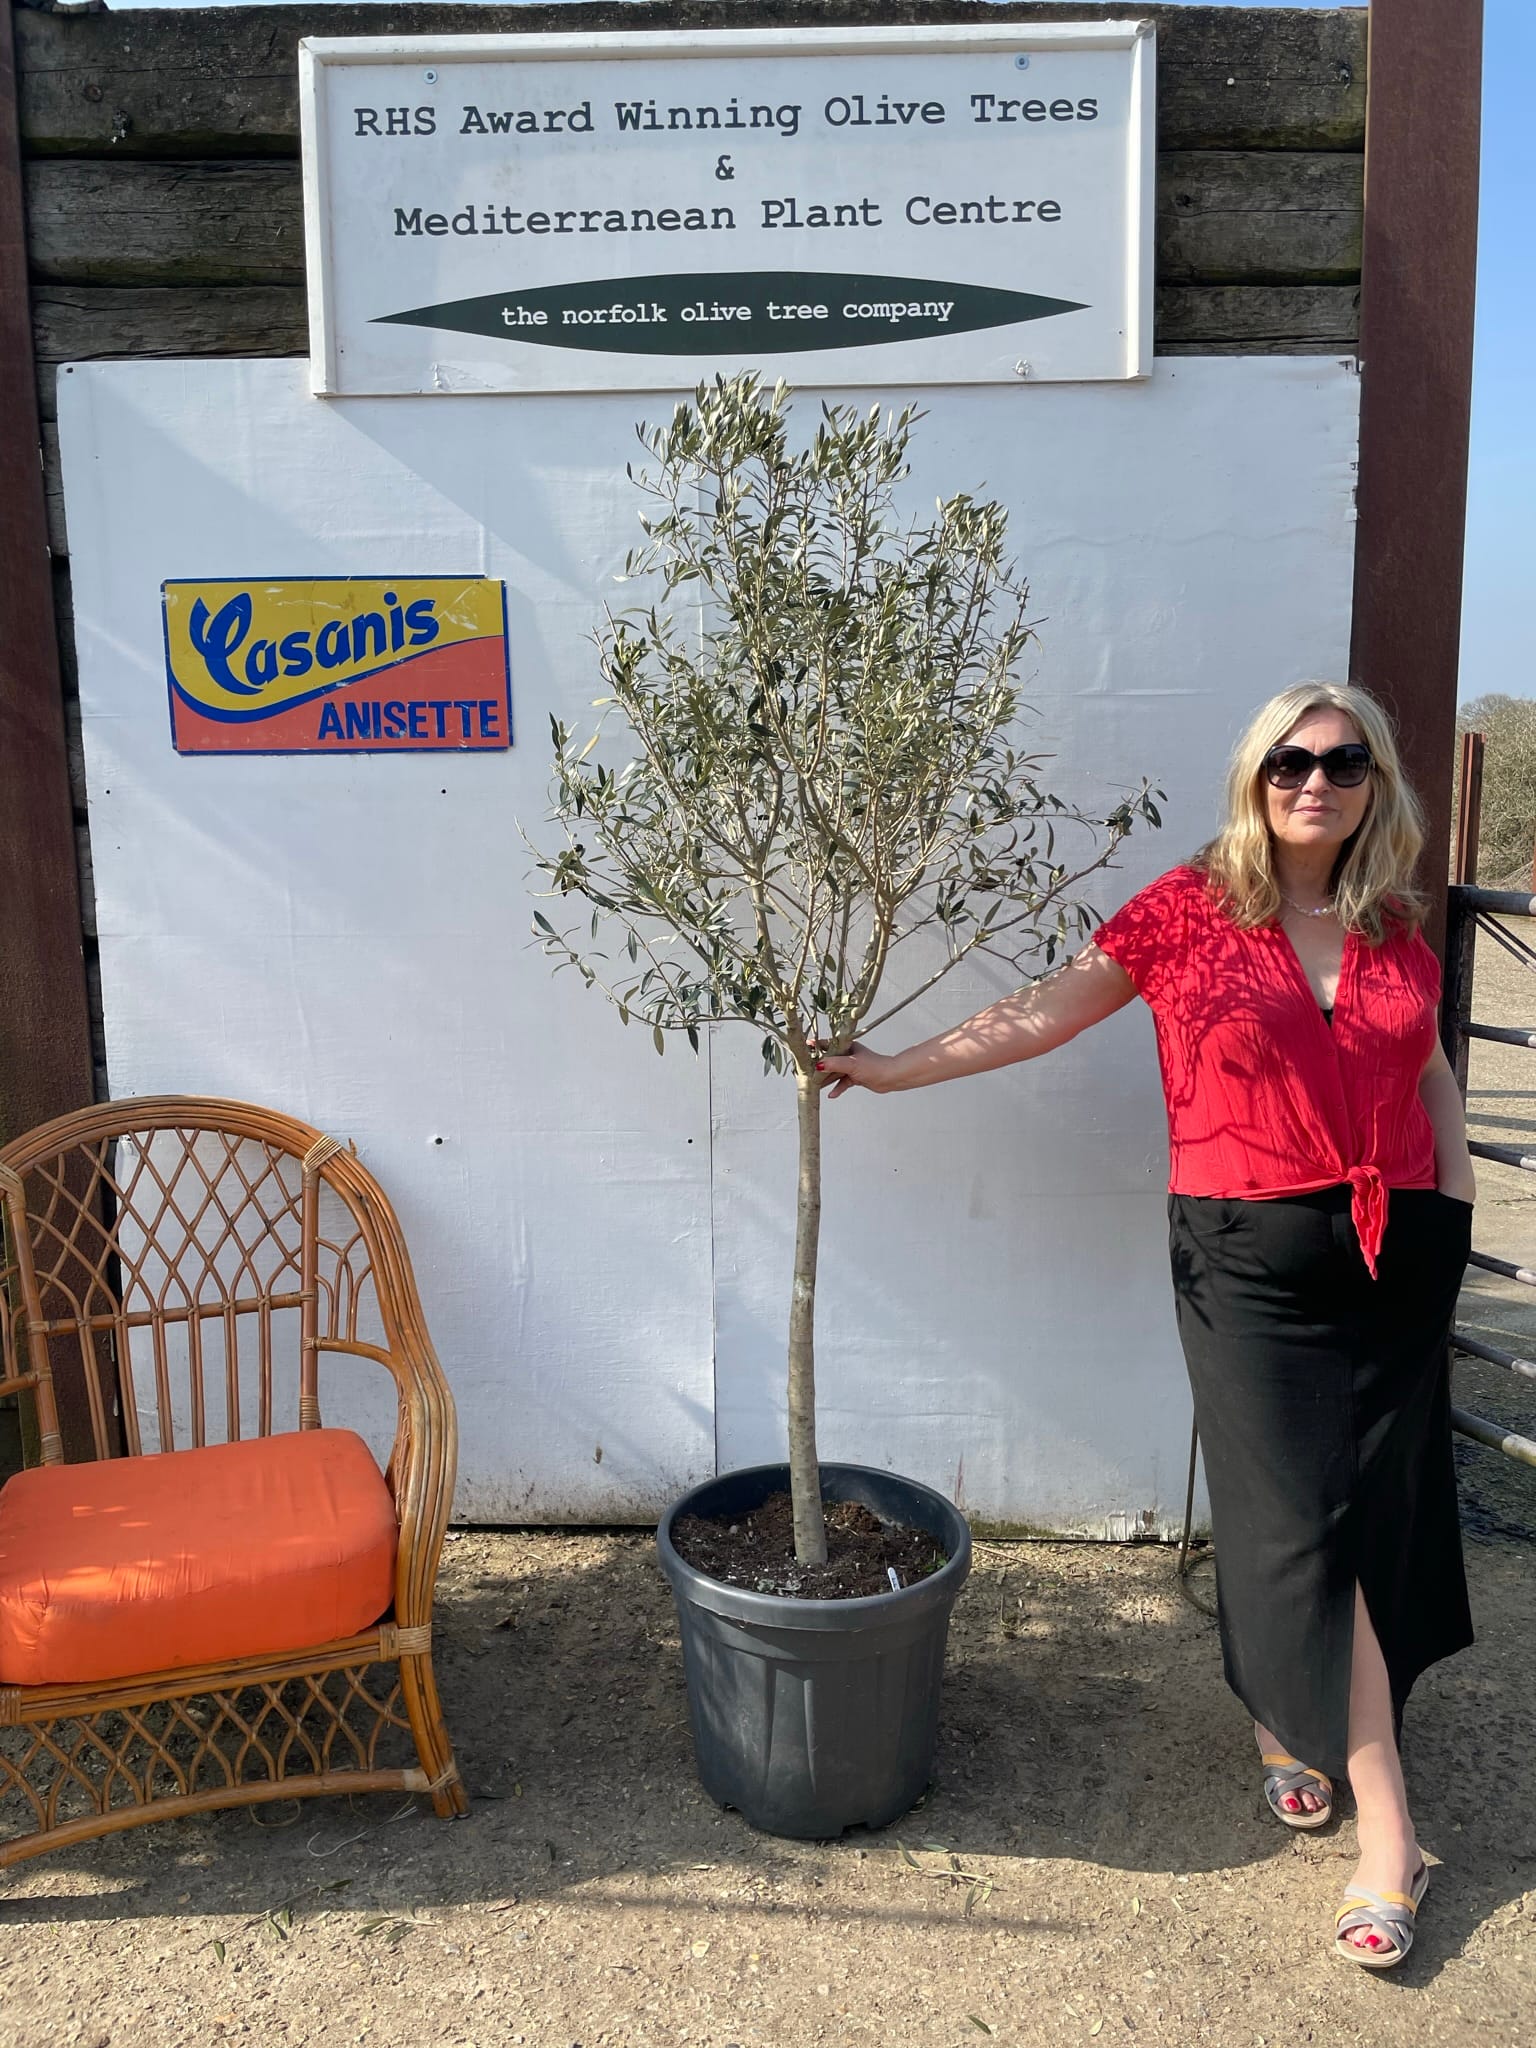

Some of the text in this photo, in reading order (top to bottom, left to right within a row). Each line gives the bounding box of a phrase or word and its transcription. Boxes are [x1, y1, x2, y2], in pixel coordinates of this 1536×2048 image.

[354, 95, 1098, 136] RHS Award Winning Olive Trees
[715, 155, 735, 180] &
[394, 195, 1061, 235] Mediterranean Plant Centre
[502, 302, 954, 325] the norfolk olive tree company
[189, 591, 439, 695] Casanis
[317, 700, 499, 740] ANISETTE
